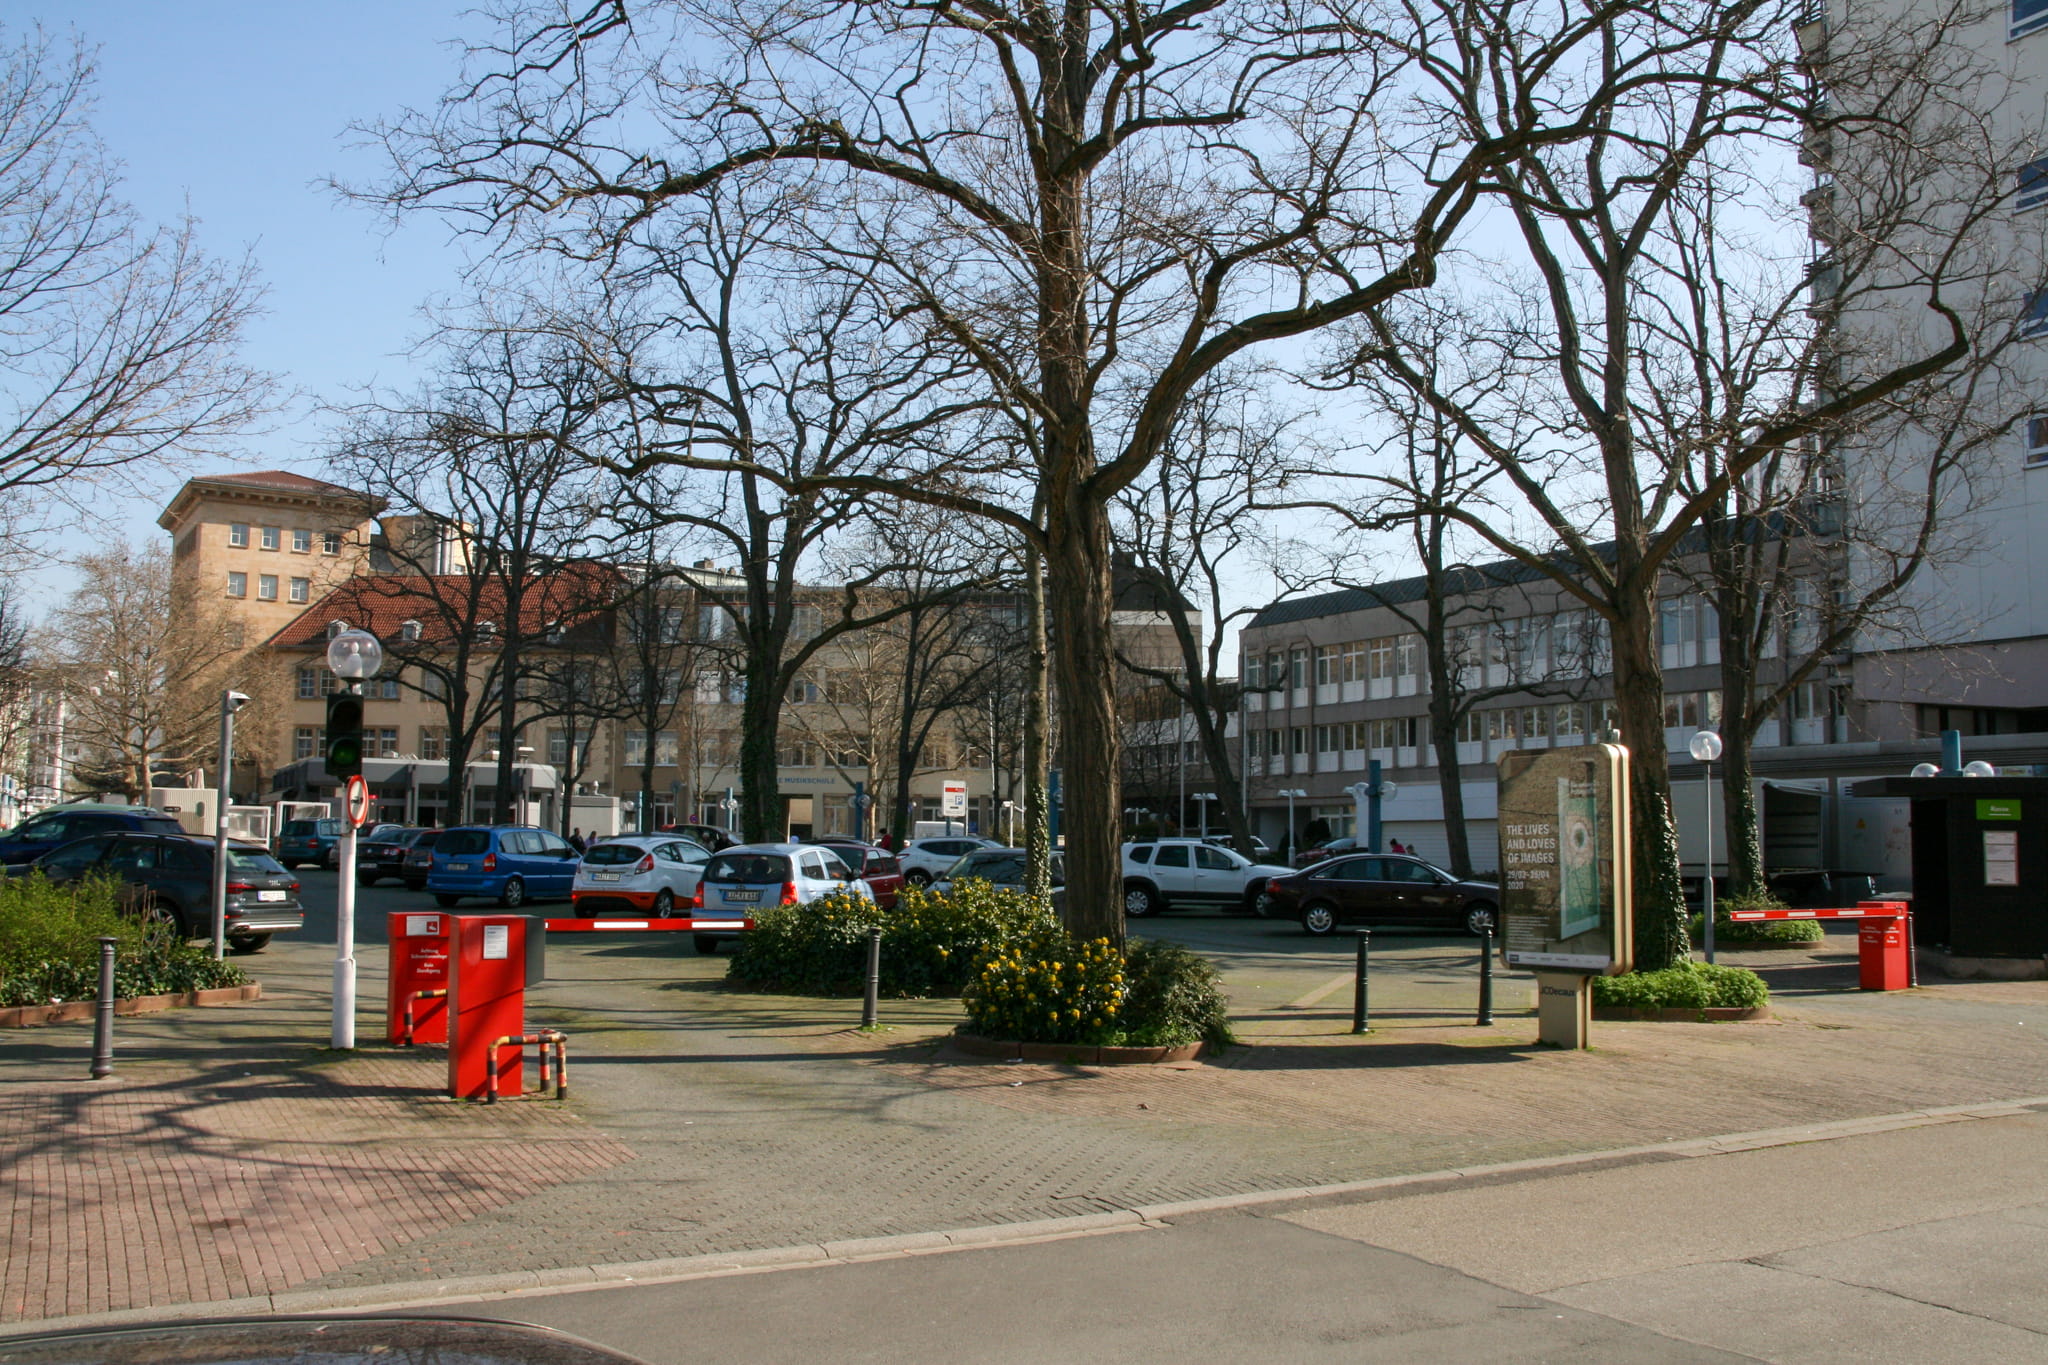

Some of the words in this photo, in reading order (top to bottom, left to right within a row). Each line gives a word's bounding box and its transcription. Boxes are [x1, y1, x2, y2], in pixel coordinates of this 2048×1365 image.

[1506, 825, 1524, 835] THE
[1525, 824, 1550, 835] LIVES
[1507, 838, 1526, 850] AND
[1527, 838, 1556, 850] LOVES
[1507, 852, 1520, 864] OF
[1520, 852, 1555, 864] IMAGES
